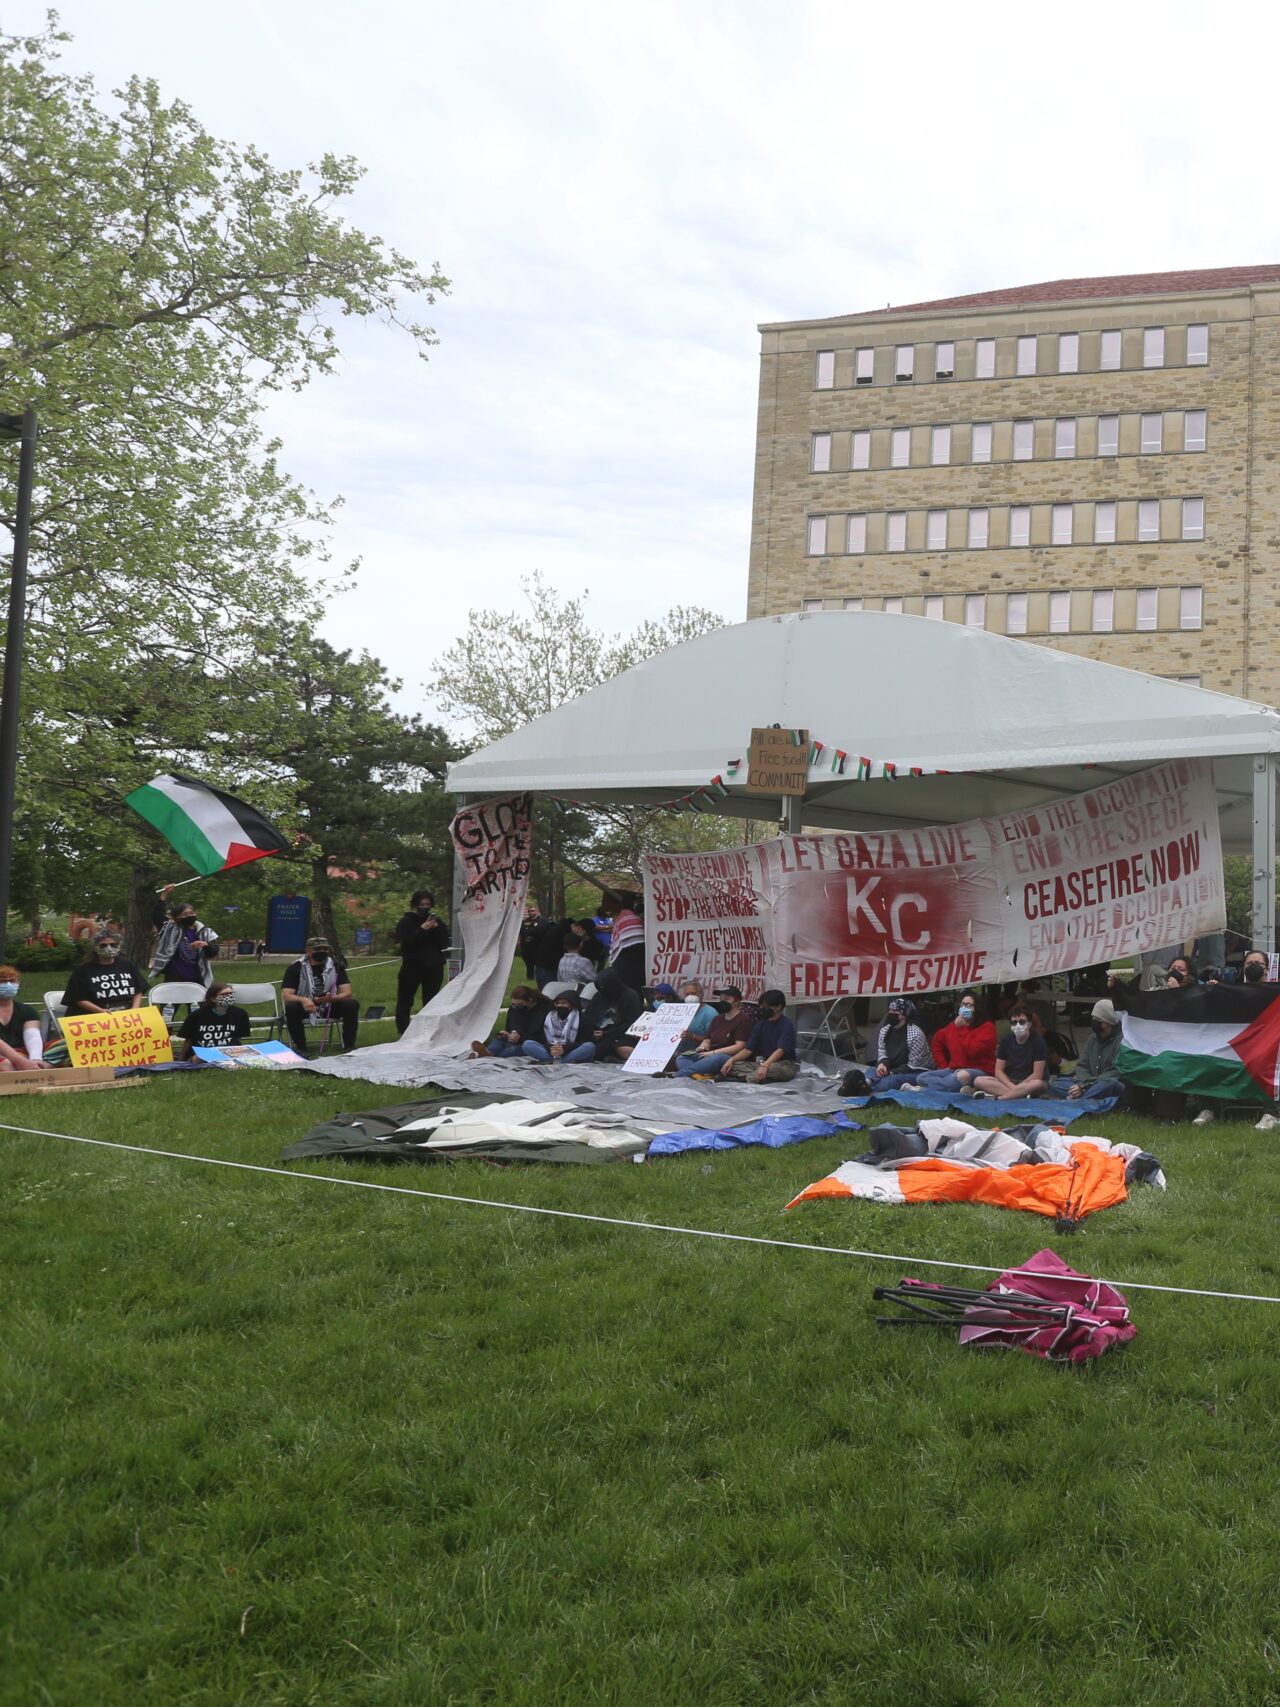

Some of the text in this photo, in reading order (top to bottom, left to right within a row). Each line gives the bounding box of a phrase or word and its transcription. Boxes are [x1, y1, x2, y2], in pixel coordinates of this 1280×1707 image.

[748, 770, 807, 791] COMMUNITY
[1000, 812, 1041, 842] END
[1048, 798, 1083, 832] THE
[1009, 834, 1064, 875] END
[1123, 786, 1193, 847] SIEGE
[780, 824, 977, 874] LET GAZA LIVE
[646, 851, 753, 879] STOP THE GENOCIDE
[1023, 830, 1201, 921] CEASEFIRE NOW
[652, 878, 686, 901] SAVE
[655, 897, 691, 922] STOP
[691, 897, 715, 919] THE
[846, 875, 931, 951] KC
[1029, 870, 1220, 949] END THE OCCUPATION
[657, 926, 767, 953] SAVE THE CHILDREN
[651, 951, 767, 976] STOP THE GENOCIDE
[1028, 940, 1082, 974] END
[91, 973, 116, 983] NOT
[100, 980, 131, 990] OUR
[790, 950, 988, 997] FREE PALESTINE
[96, 987, 136, 999] NAME
[67, 1013, 144, 1037] JEWISH
[74, 1027, 153, 1051] PROFESSOR
[80, 1049, 117, 1066] SAYS
[121, 1041, 146, 1058] NOT
